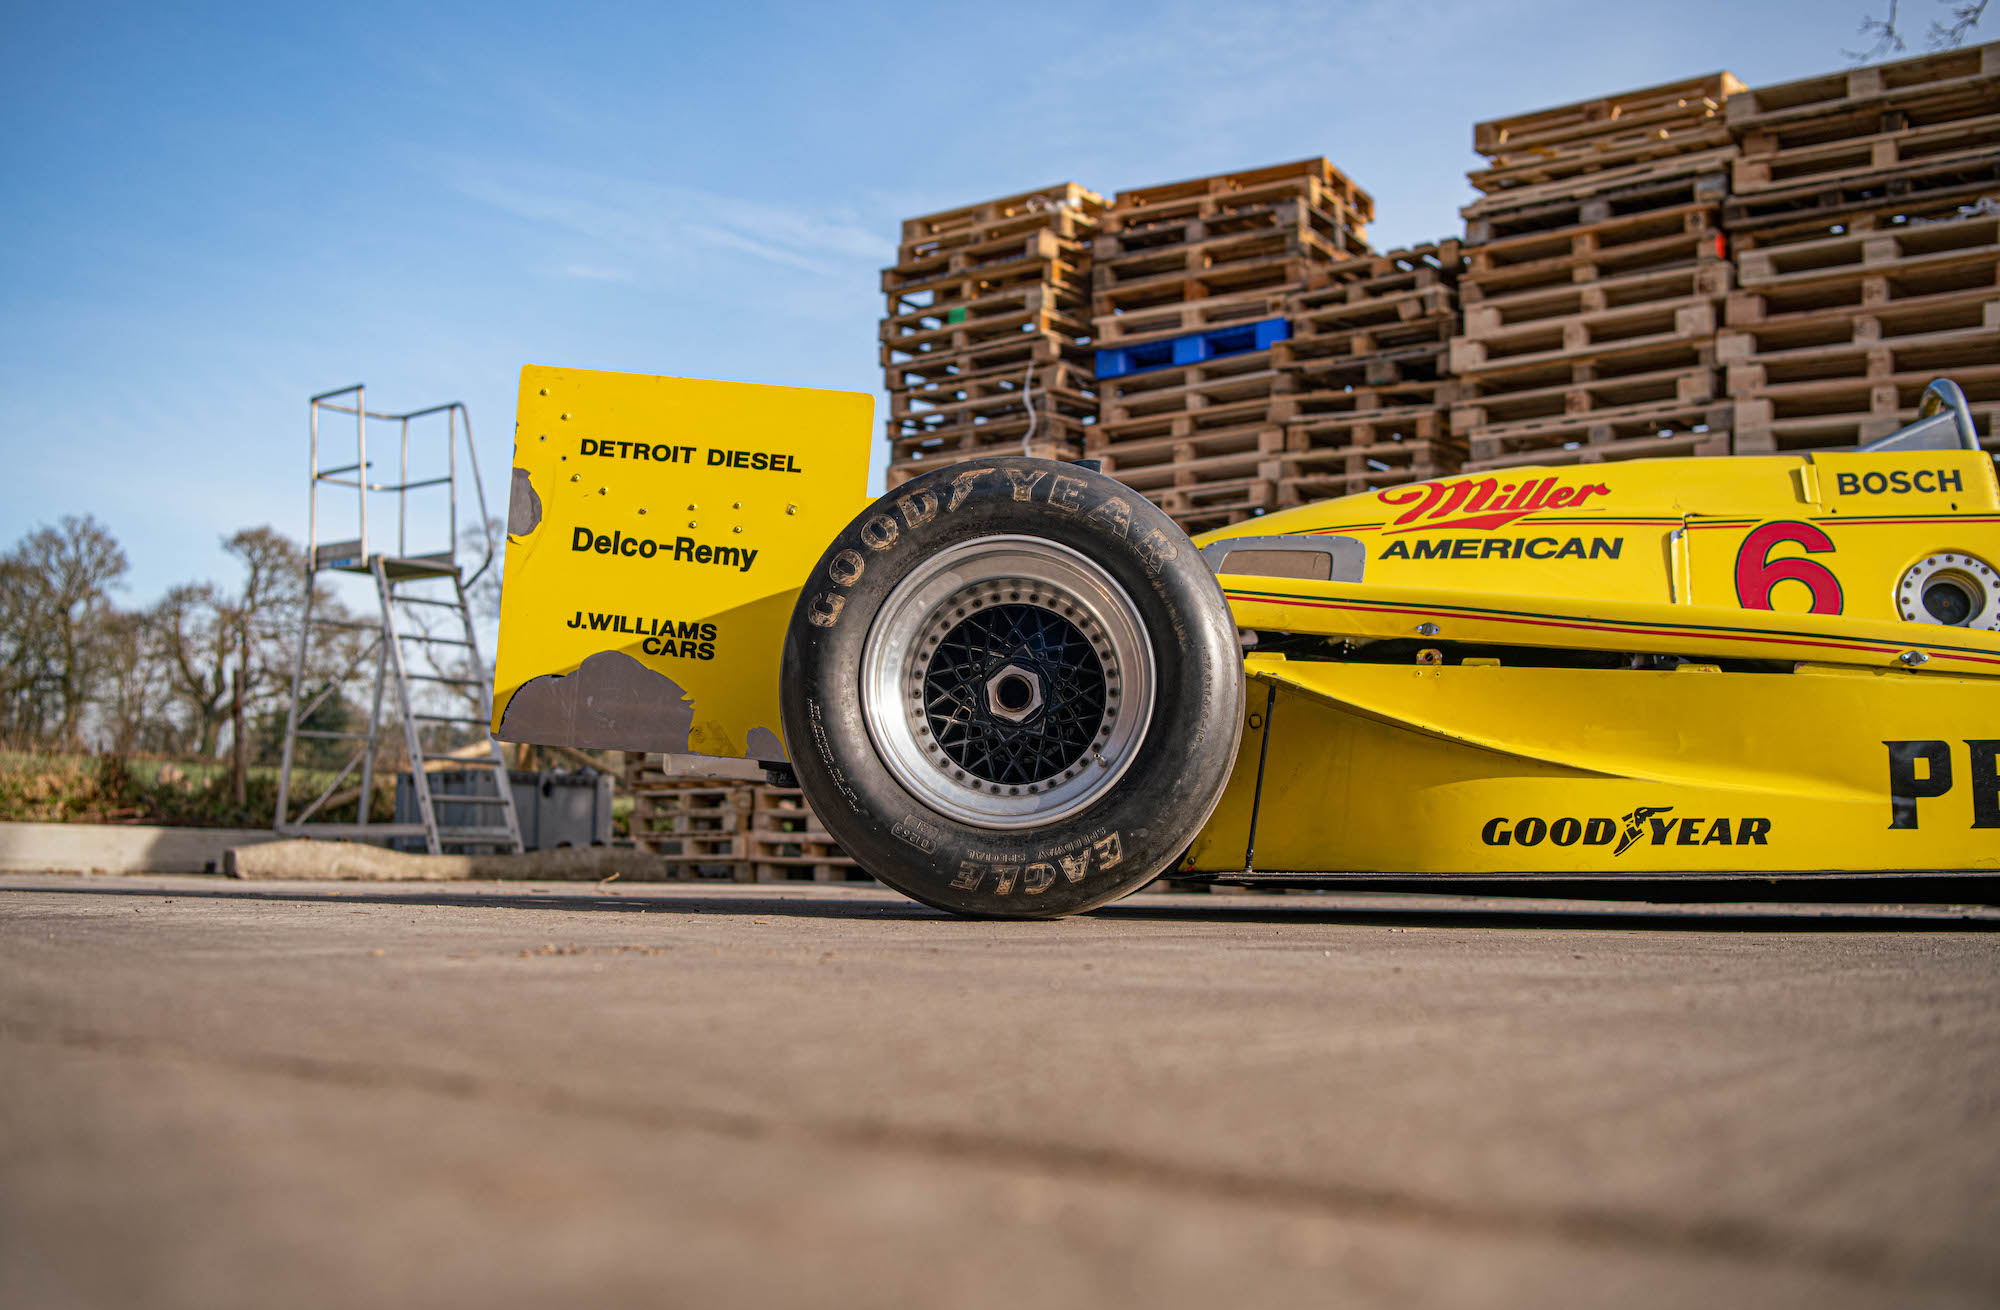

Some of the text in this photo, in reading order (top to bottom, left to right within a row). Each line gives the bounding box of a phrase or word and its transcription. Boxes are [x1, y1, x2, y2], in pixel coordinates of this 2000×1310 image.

[581, 438, 802, 473] DETROIT DIESEL
[1836, 469, 1963, 496] BOSCH
[1377, 476, 1611, 525] Miller
[571, 526, 759, 572] Delco-Remy
[1378, 537, 1624, 560] AMERICAN
[1734, 519, 1844, 616] 6
[566, 611, 718, 642] J.WILLIAMS
[641, 636, 716, 661] CARS
[967, 827, 1106, 862] SPEEDWAY SPECIAL
[950, 831, 1123, 896] EAGLE
